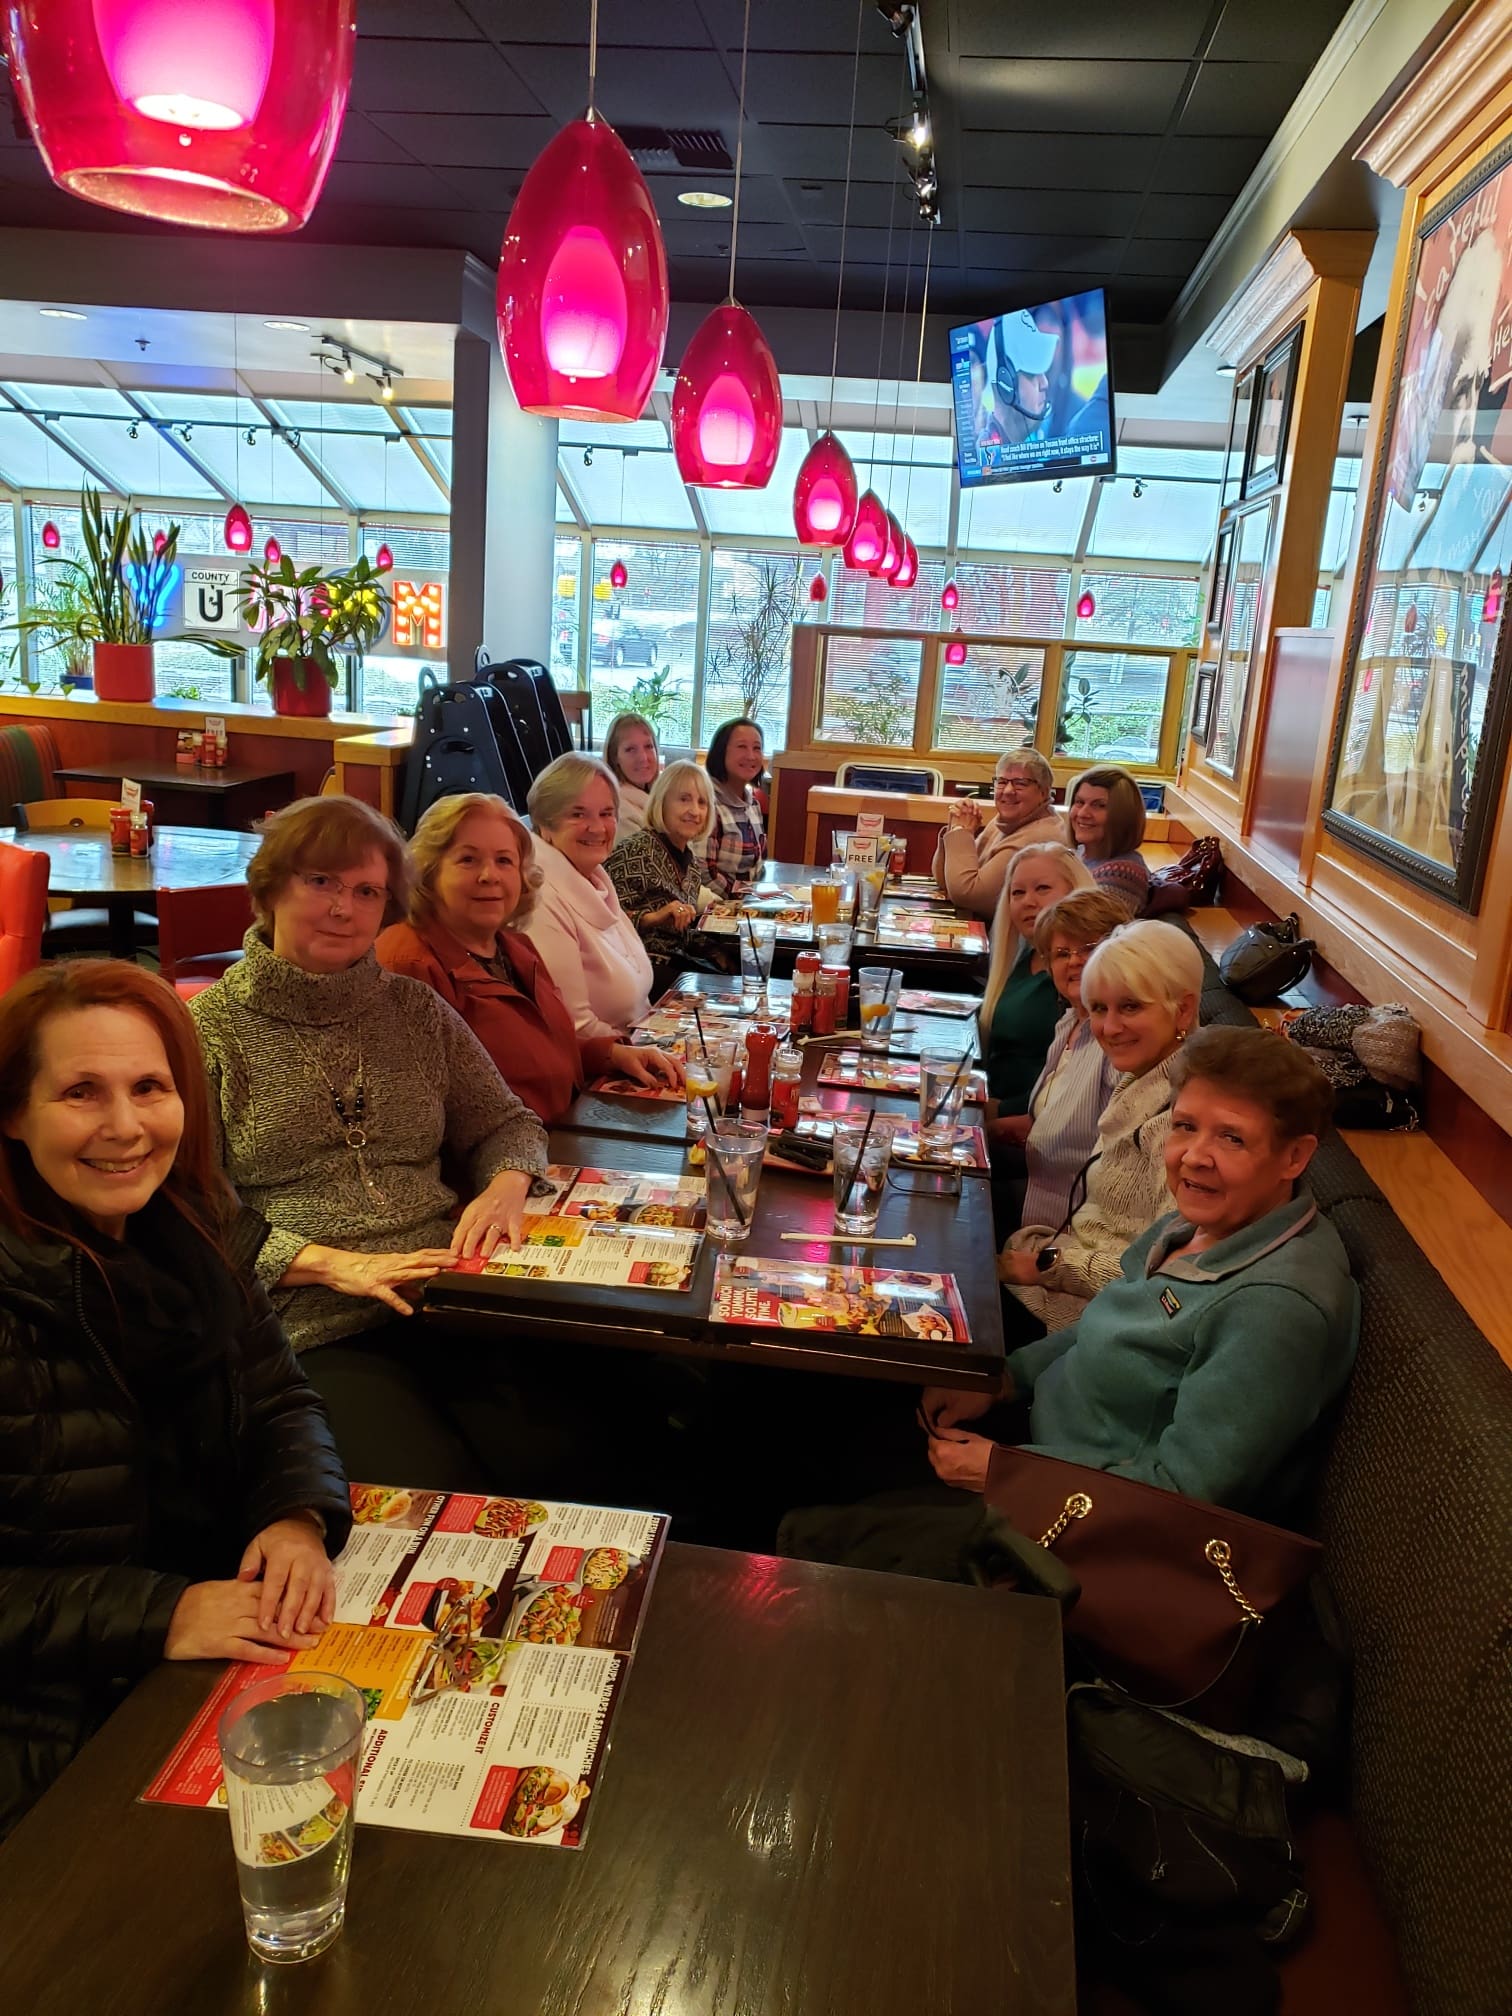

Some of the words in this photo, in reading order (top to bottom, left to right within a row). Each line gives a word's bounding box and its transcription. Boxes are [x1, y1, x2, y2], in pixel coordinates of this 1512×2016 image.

[191, 571, 230, 582] COUNTY
[198, 587, 224, 622] U
[392, 581, 445, 648] M
[848, 854, 874, 863] FREE
[420, 1514, 435, 1526] FUN
[597, 1683, 614, 1712] WRAPS
[476, 1701, 501, 1745] CUSTOMIZE
[358, 1728, 389, 1776] ADDITIONAL
[472, 1745, 484, 1754] IT
[579, 1719, 604, 1775] SANDWICHES
